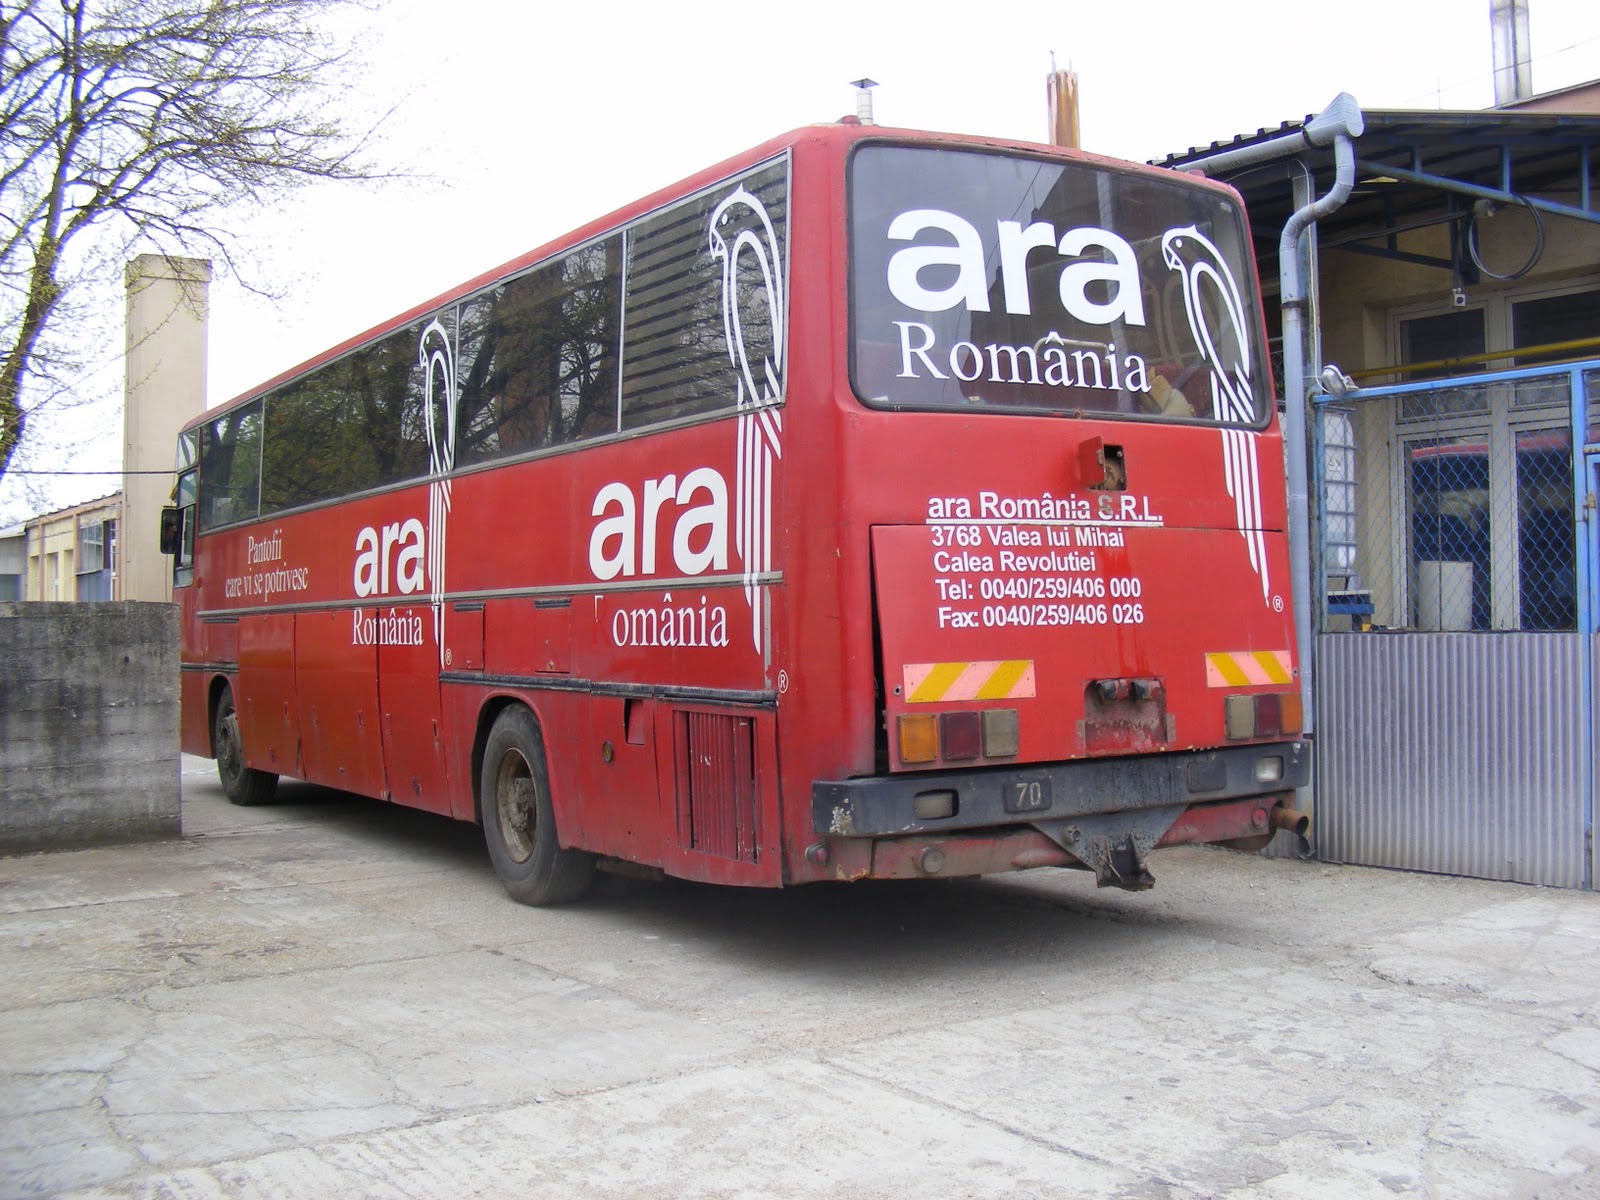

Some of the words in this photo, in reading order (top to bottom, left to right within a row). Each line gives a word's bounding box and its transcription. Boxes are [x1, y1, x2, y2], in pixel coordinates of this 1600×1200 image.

[887, 209, 1146, 327] ara
[892, 321, 1152, 393] România
[589, 467, 729, 581] ara
[928, 499, 970, 519] ara
[979, 492, 1090, 520] România
[1098, 495, 1163, 521] S.R.L.
[248, 529, 282, 564] Pantofii
[931, 525, 981, 546] 3768
[991, 527, 1042, 546] Valea
[1047, 527, 1069, 546] lui
[1075, 527, 1124, 548] Mihai
[354, 518, 425, 598] ara
[934, 552, 993, 572] Calea
[1000, 552, 1096, 572] Revolutiei
[225, 577, 242, 598] care
[244, 567, 252, 595] vi
[254, 574, 263, 595] se
[264, 562, 309, 603] potrivesc
[935, 579, 973, 600] Tel:
[980, 578, 1104, 600] 0040/259/406
[1110, 577, 1141, 598] 000
[352, 607, 424, 646] România
[938, 607, 979, 628] Fax:
[982, 606, 1107, 627] 0040/259/406
[1113, 605, 1143, 624] 026
[1016, 781, 1042, 807] 70
